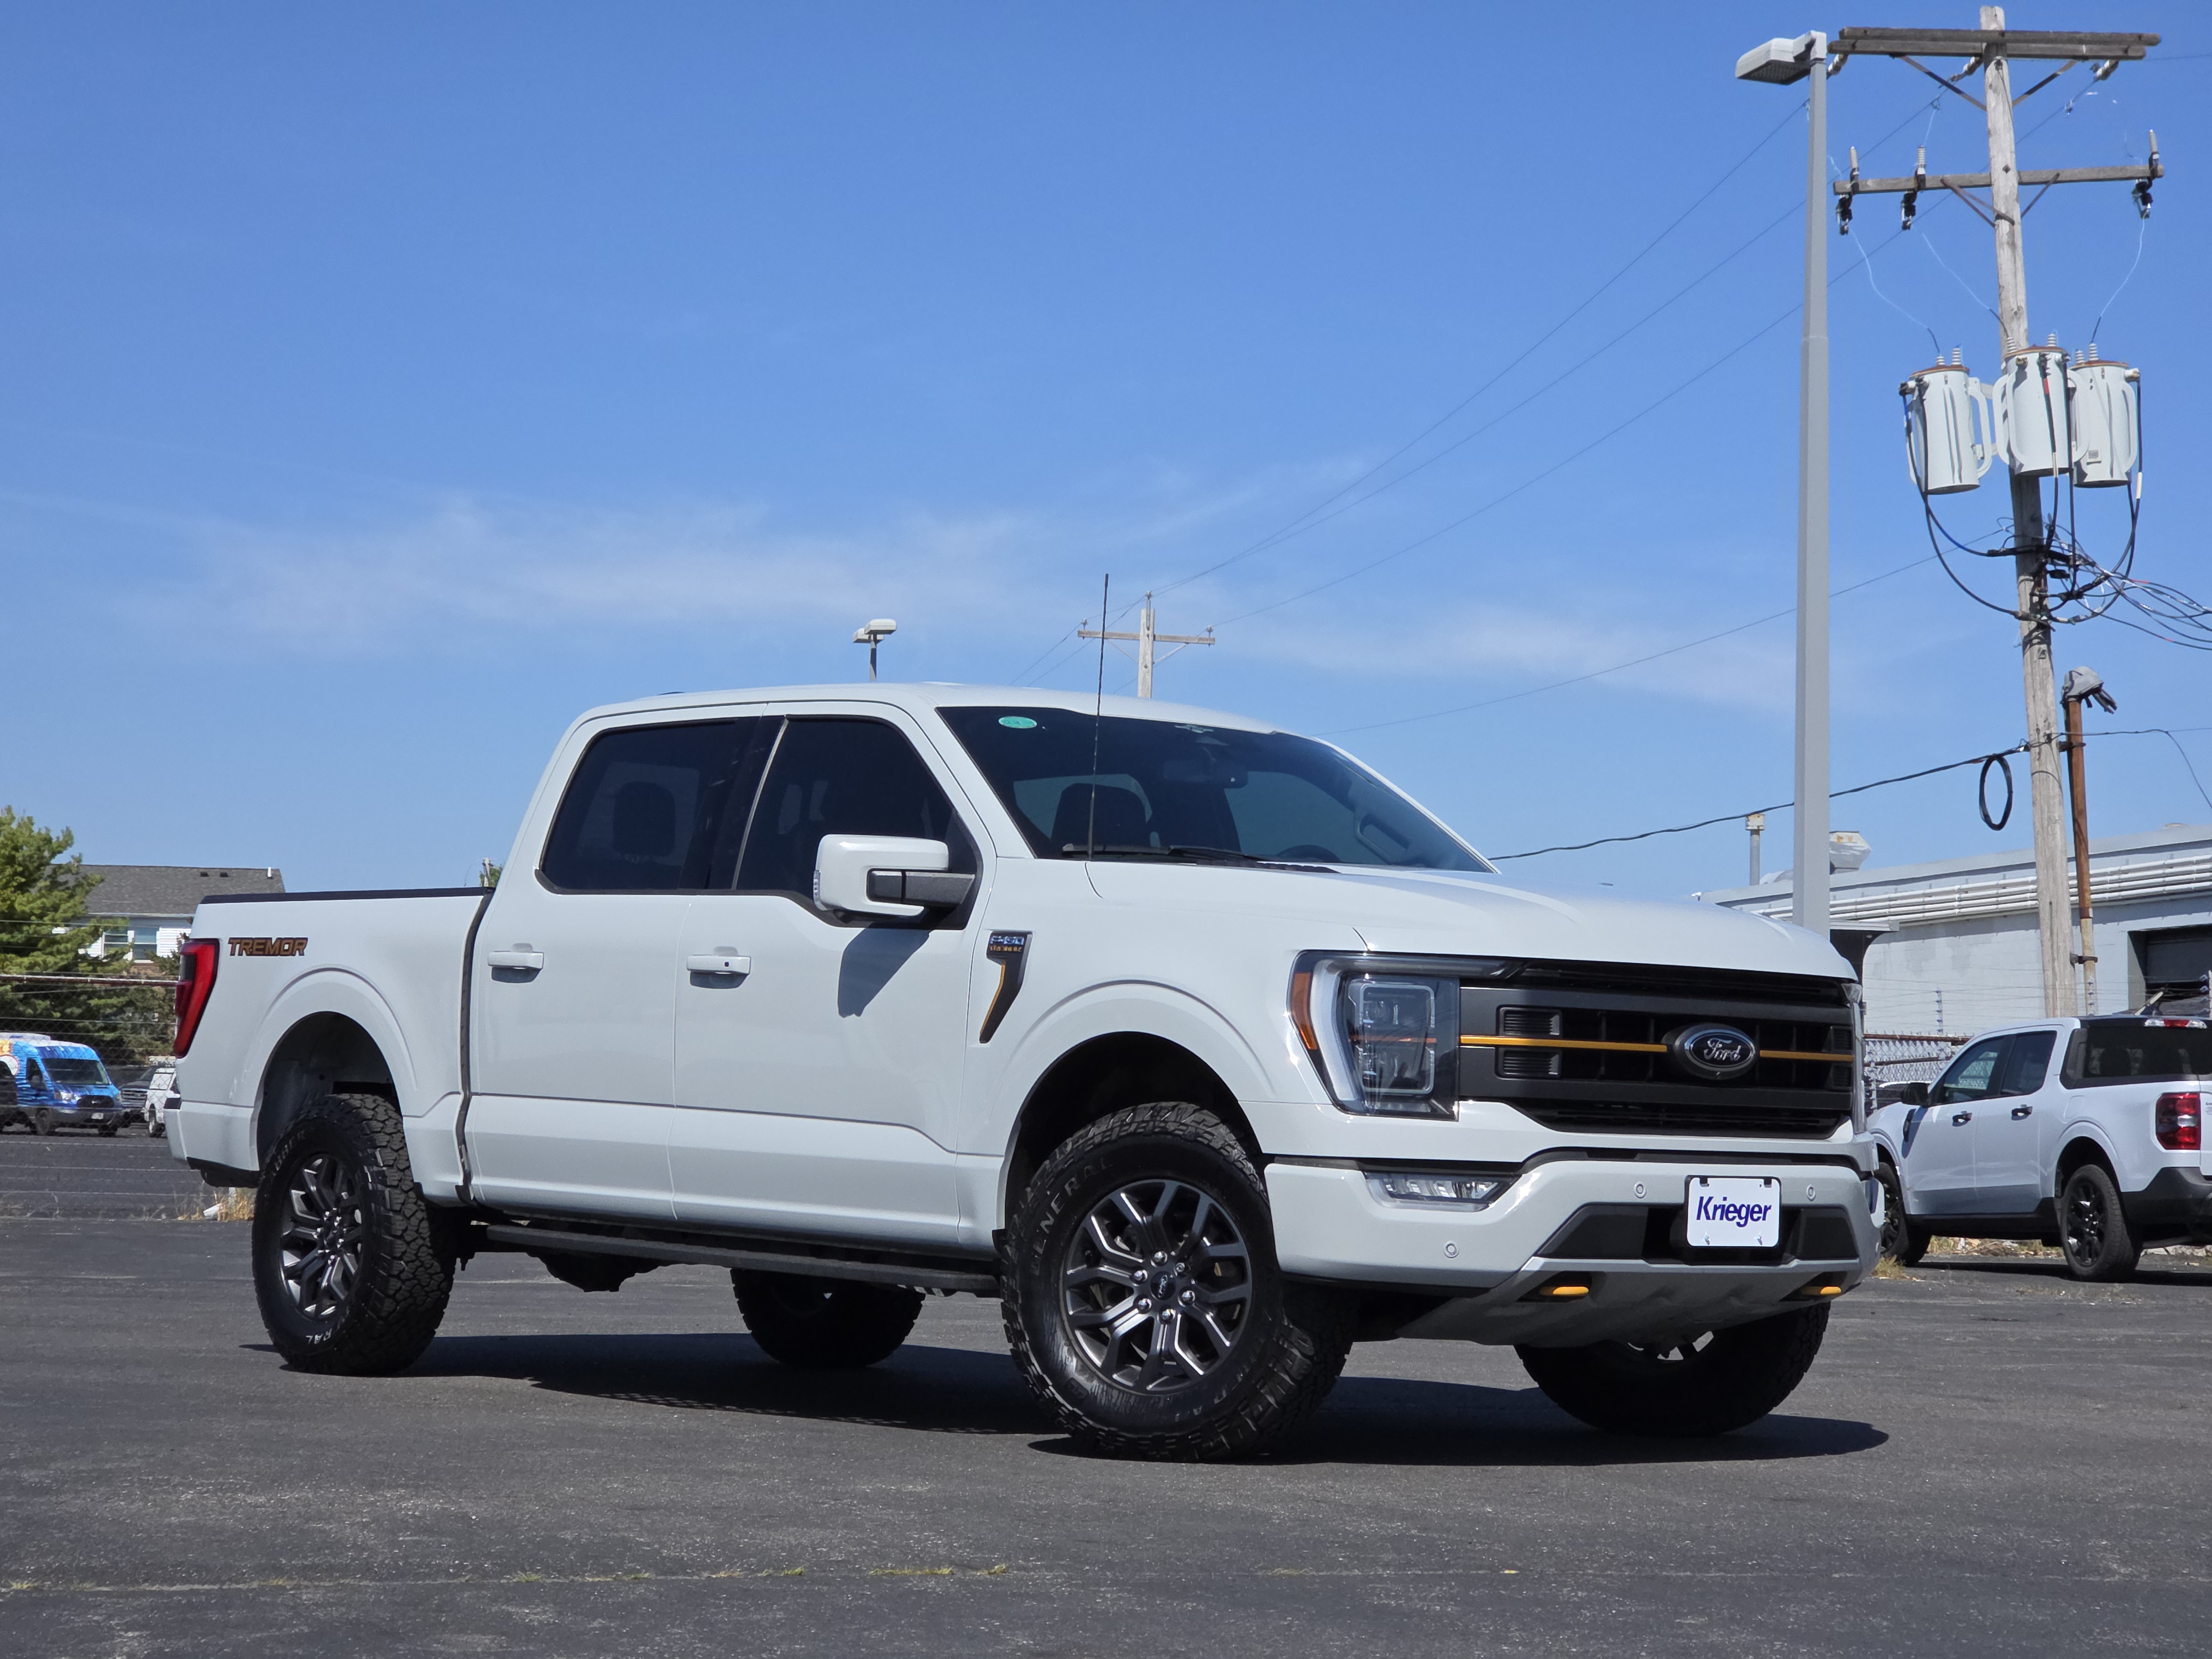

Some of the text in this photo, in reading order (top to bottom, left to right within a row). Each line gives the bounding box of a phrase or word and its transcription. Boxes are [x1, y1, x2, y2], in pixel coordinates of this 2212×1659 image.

[227, 937, 308, 957] TREMOR
[1703, 1037, 1741, 1061] Ford
[1696, 1196, 1772, 1227] Krieger
